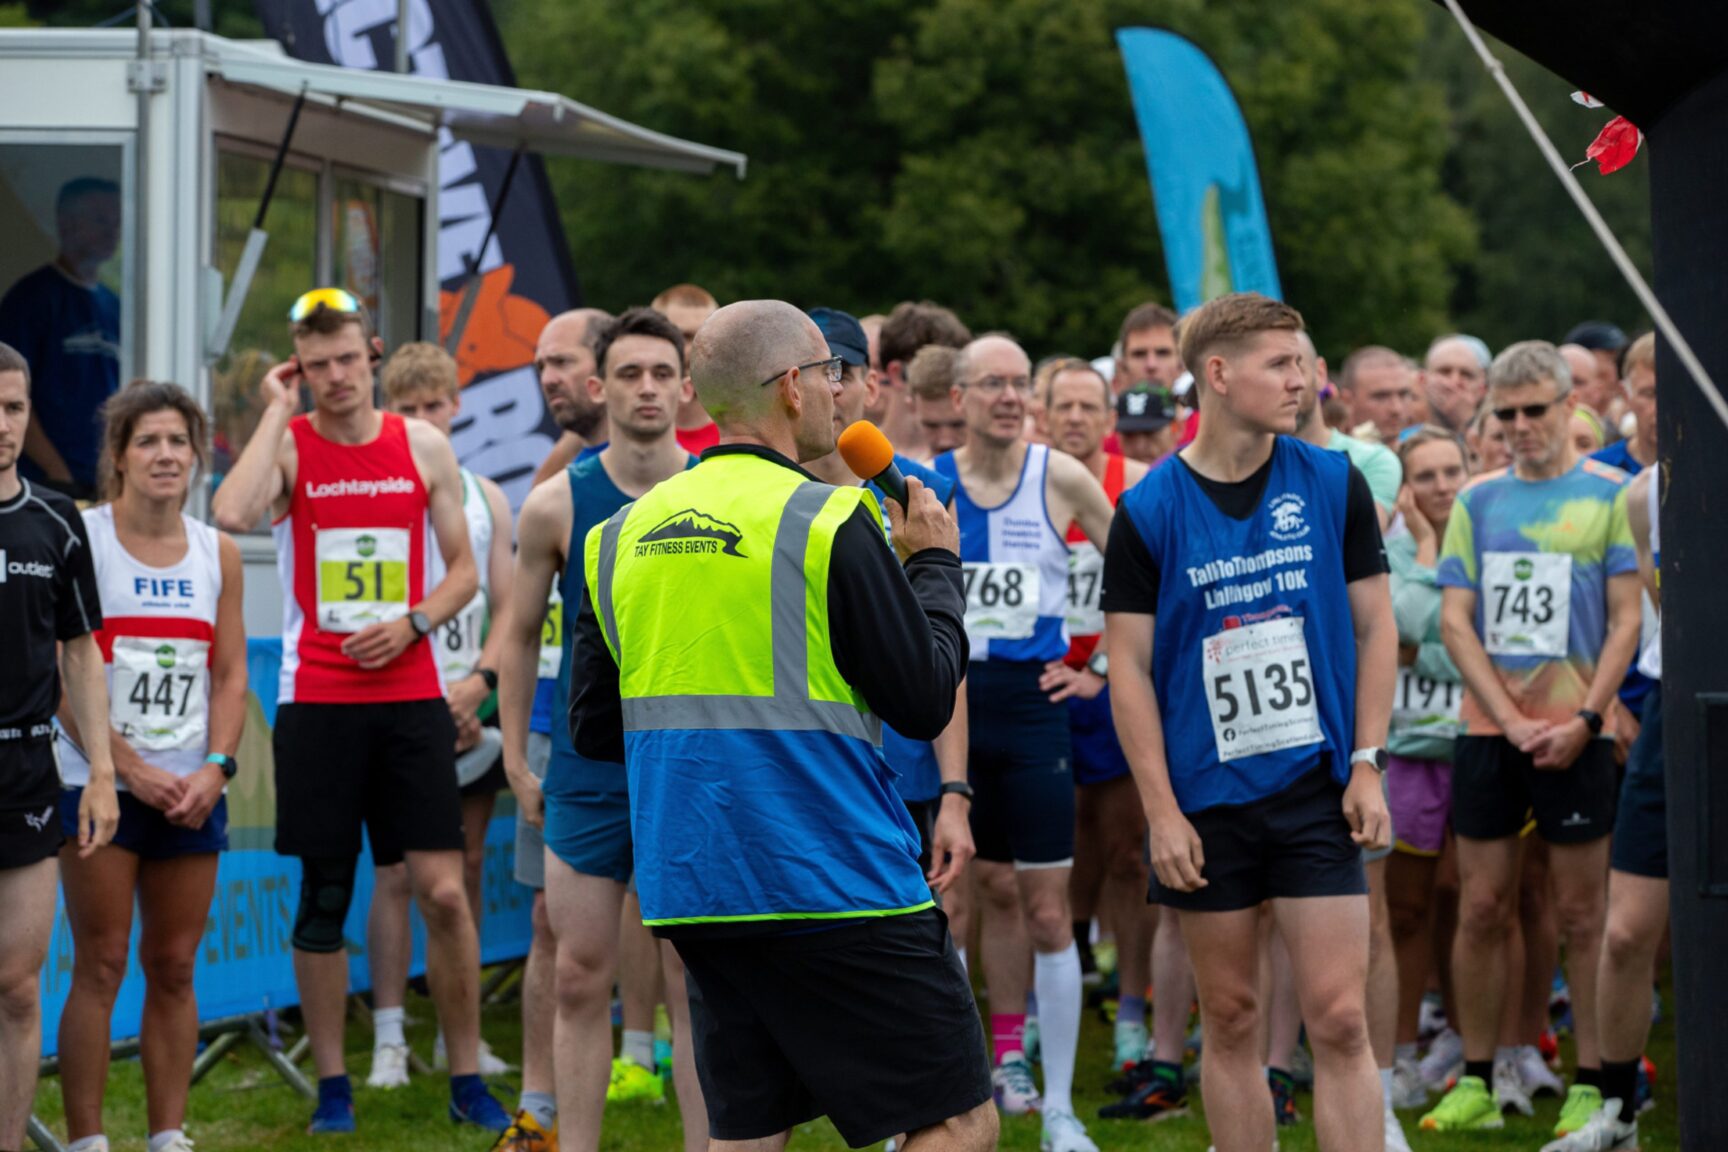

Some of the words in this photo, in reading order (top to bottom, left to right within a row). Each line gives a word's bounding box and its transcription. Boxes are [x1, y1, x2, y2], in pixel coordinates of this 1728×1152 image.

[305, 477, 415, 498] Lochtayside
[634, 544, 650, 558] TAY
[649, 541, 684, 556] FITNESS
[685, 540, 718, 555] EVENTS
[134, 576, 195, 598] FIFE
[344, 562, 384, 601] 51
[963, 568, 1023, 607] 768
[1275, 568, 1308, 592] 10K
[1493, 585, 1554, 624] 743
[1226, 636, 1269, 656] perfect
[128, 672, 196, 717] 447
[1214, 658, 1312, 723] 5135
